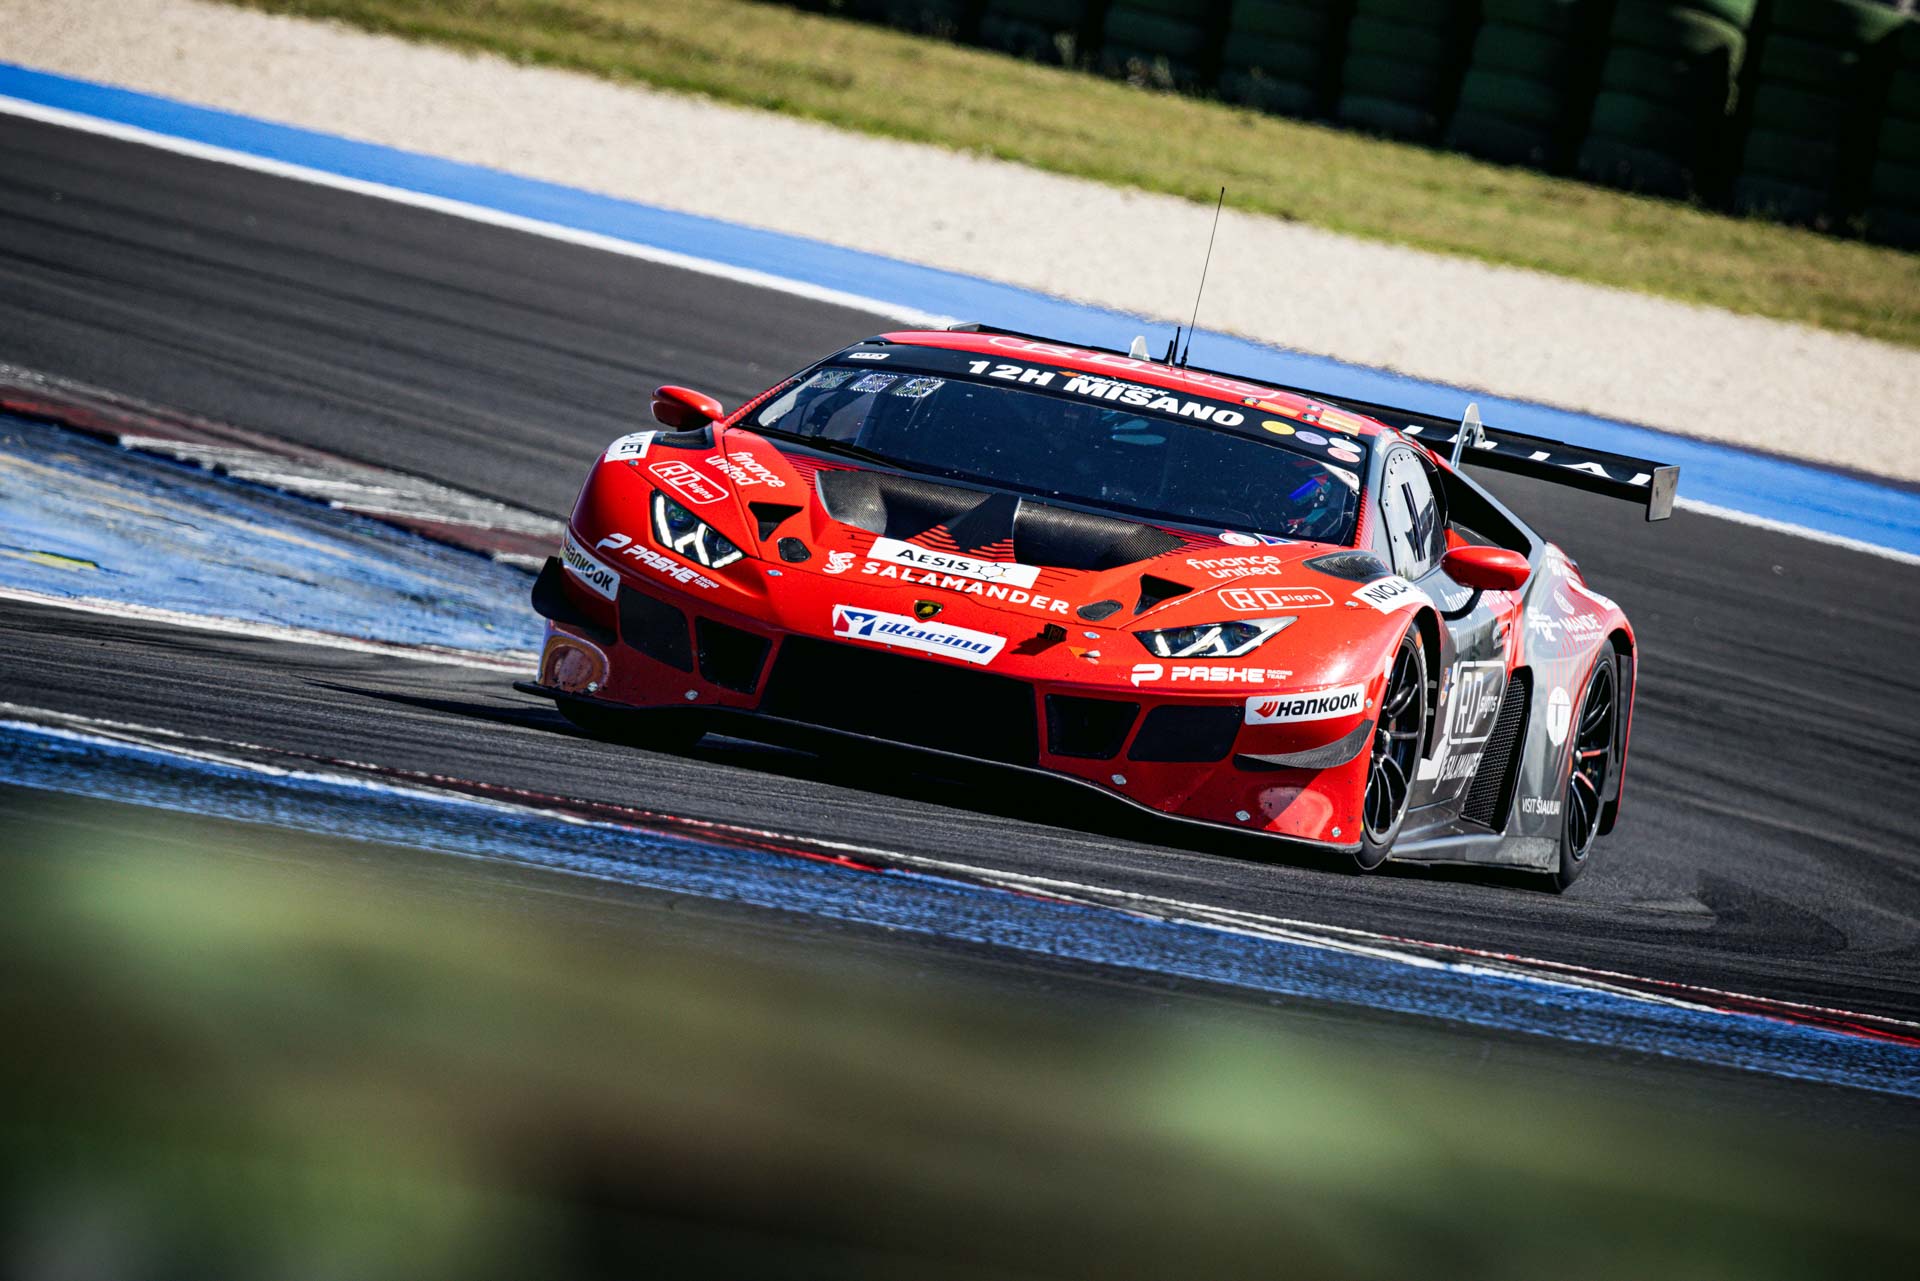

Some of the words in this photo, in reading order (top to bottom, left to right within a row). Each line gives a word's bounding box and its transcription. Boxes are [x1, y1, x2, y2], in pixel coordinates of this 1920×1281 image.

[968, 360, 1057, 386] 12H
[1063, 377, 1245, 427] MISANO
[656, 464, 701, 486] RD
[705, 454, 762, 486] united
[727, 451, 786, 488] finance
[896, 548, 971, 571] AESIS
[1186, 554, 1281, 570] finance
[1208, 563, 1282, 579] united
[861, 561, 1069, 615] SALAMANDER
[1229, 590, 1284, 608] RD
[1281, 593, 1322, 603] signs
[877, 621, 993, 655] iRacing
